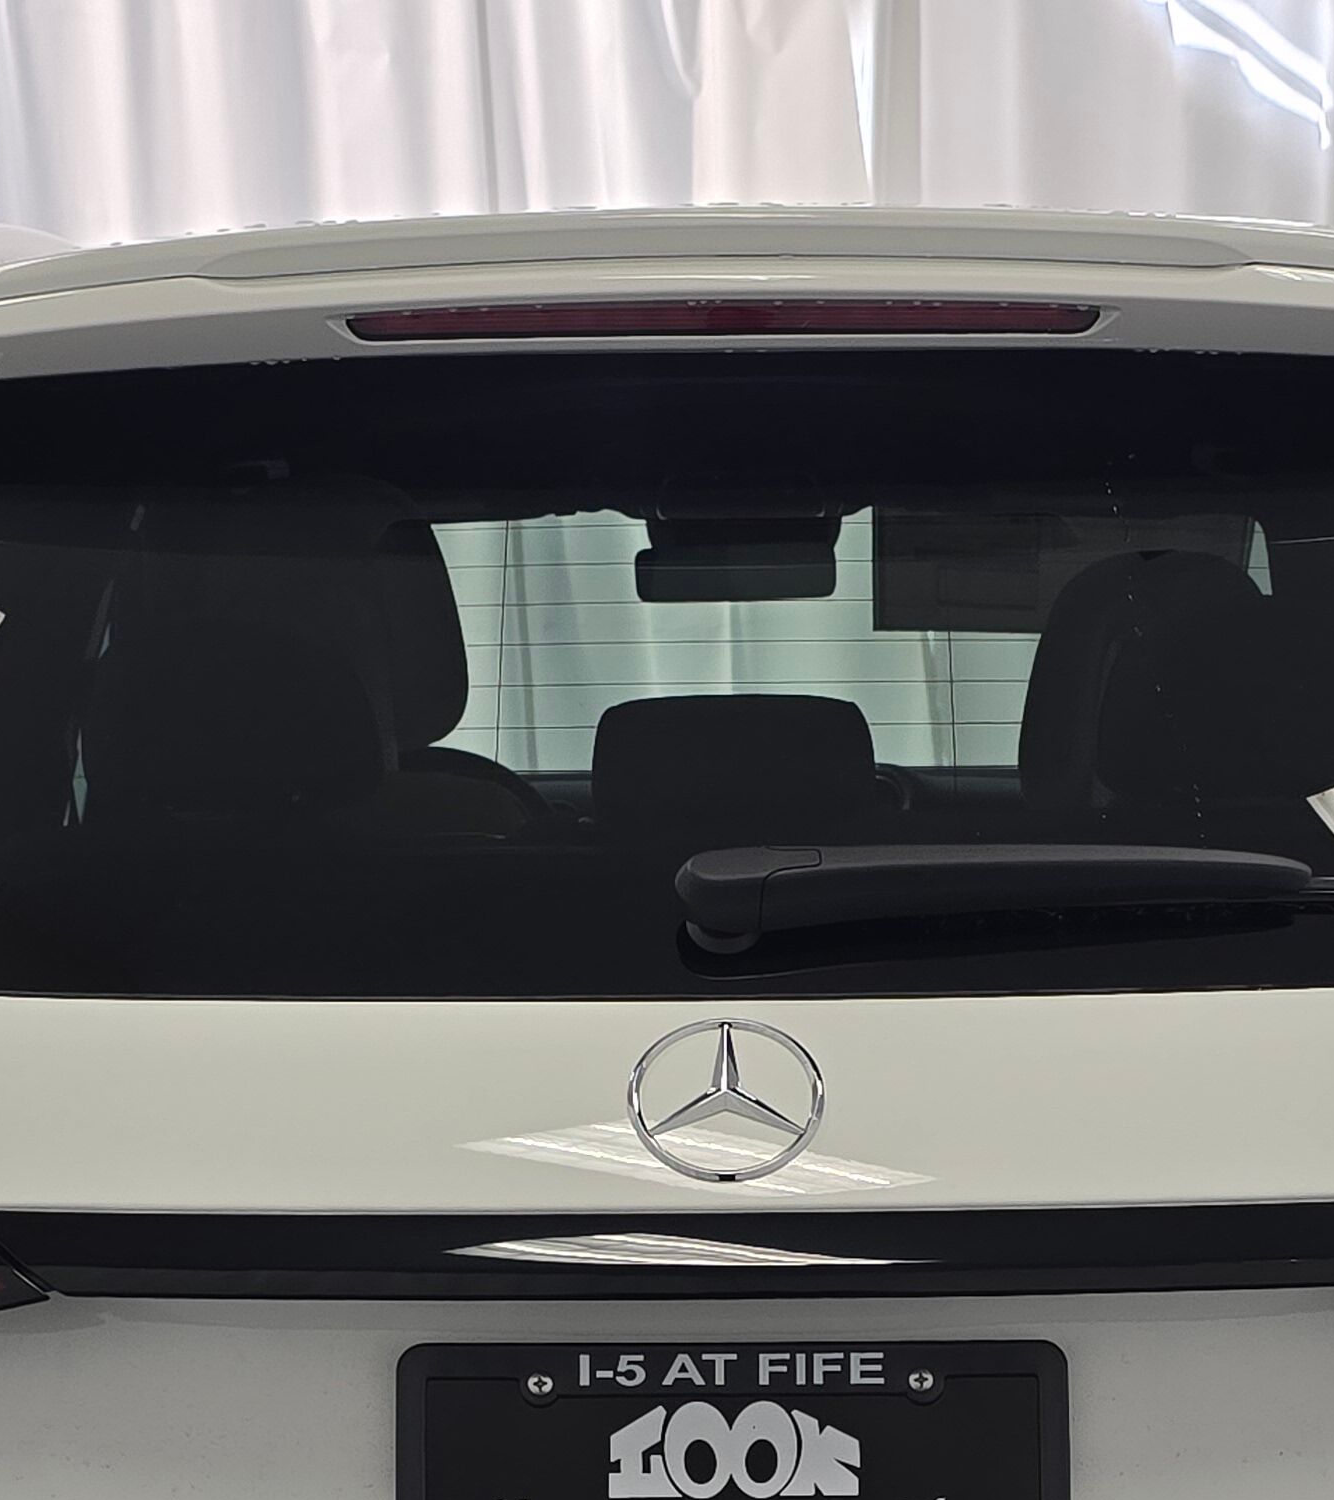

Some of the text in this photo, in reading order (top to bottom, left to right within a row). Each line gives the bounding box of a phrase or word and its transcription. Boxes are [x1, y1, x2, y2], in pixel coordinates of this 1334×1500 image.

[579, 1352, 885, 1387] I-5 AT FIFE
[609, 1401, 860, 1498] LOOK
